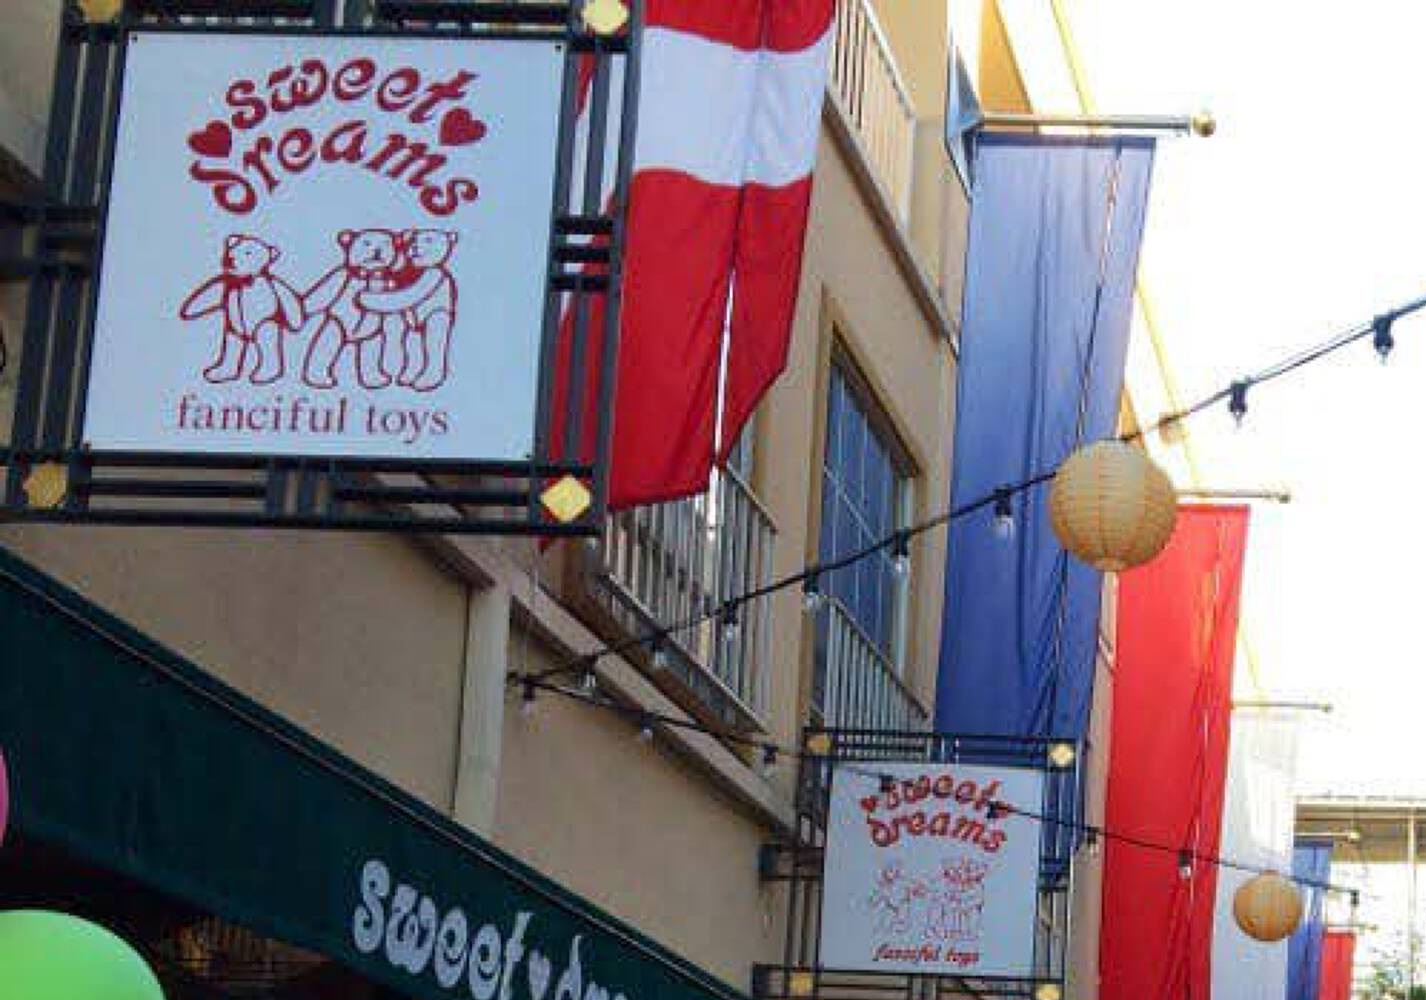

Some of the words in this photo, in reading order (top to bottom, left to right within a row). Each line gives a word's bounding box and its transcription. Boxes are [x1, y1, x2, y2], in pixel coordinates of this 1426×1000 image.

[226, 57, 479, 128] sweet
[189, 119, 479, 216] dreams
[176, 394, 347, 434] fanciful
[366, 398, 449, 443] toys
[882, 774, 1000, 808] sweet
[867, 810, 1006, 853] dreams
